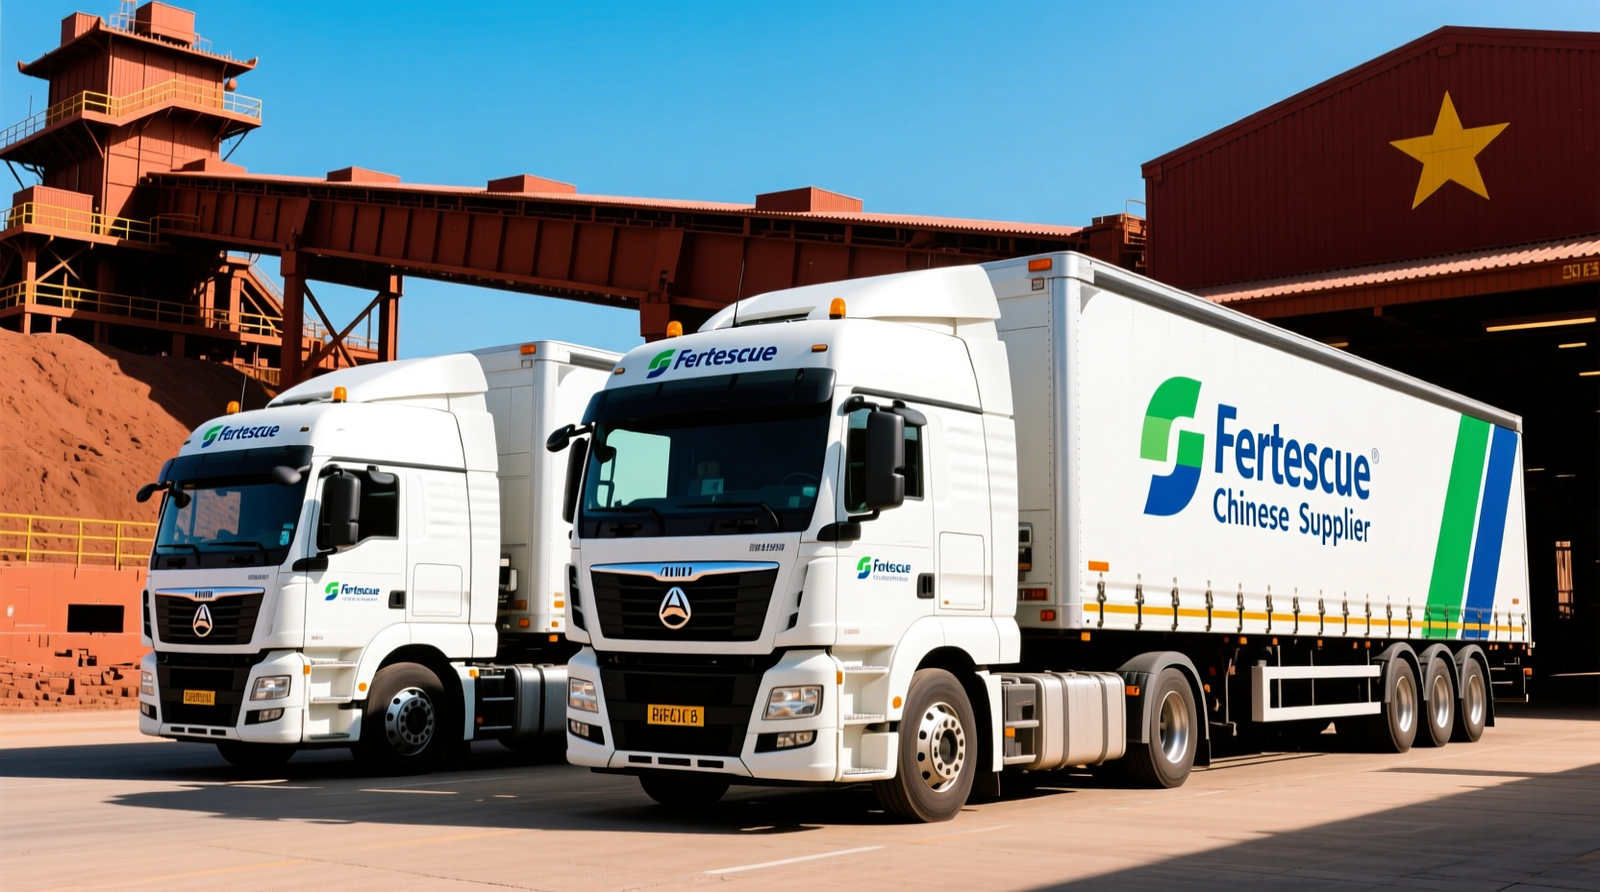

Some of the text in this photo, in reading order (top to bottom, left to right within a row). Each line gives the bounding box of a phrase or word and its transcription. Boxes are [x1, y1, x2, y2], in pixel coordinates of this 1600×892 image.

[673, 346, 778, 370] Fertescue
[1214, 403, 1371, 500] Fertescue
[1212, 487, 1371, 546] Chinese Supplier
